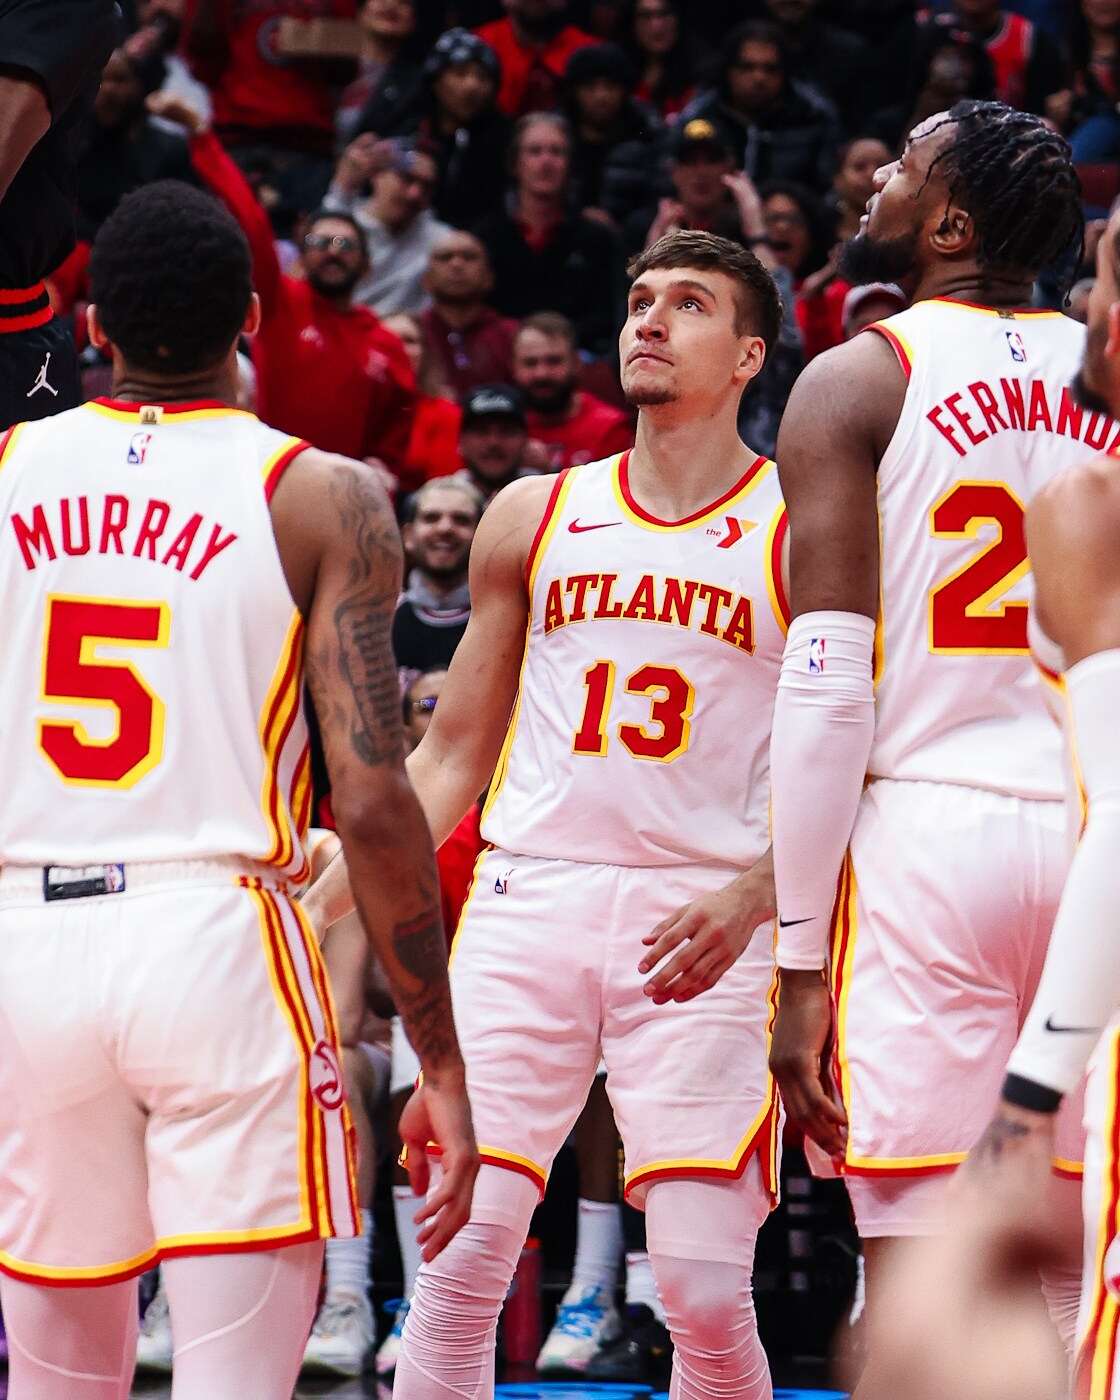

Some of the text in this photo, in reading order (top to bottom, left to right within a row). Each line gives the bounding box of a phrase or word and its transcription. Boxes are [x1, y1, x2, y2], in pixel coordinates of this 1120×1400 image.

[10, 494, 238, 581] MURRAY
[705, 528, 722, 537] the
[928, 479, 1031, 656] 2
[544, 572, 757, 657] ATLANTA
[35, 591, 172, 791] 5
[572, 659, 697, 764] 13
